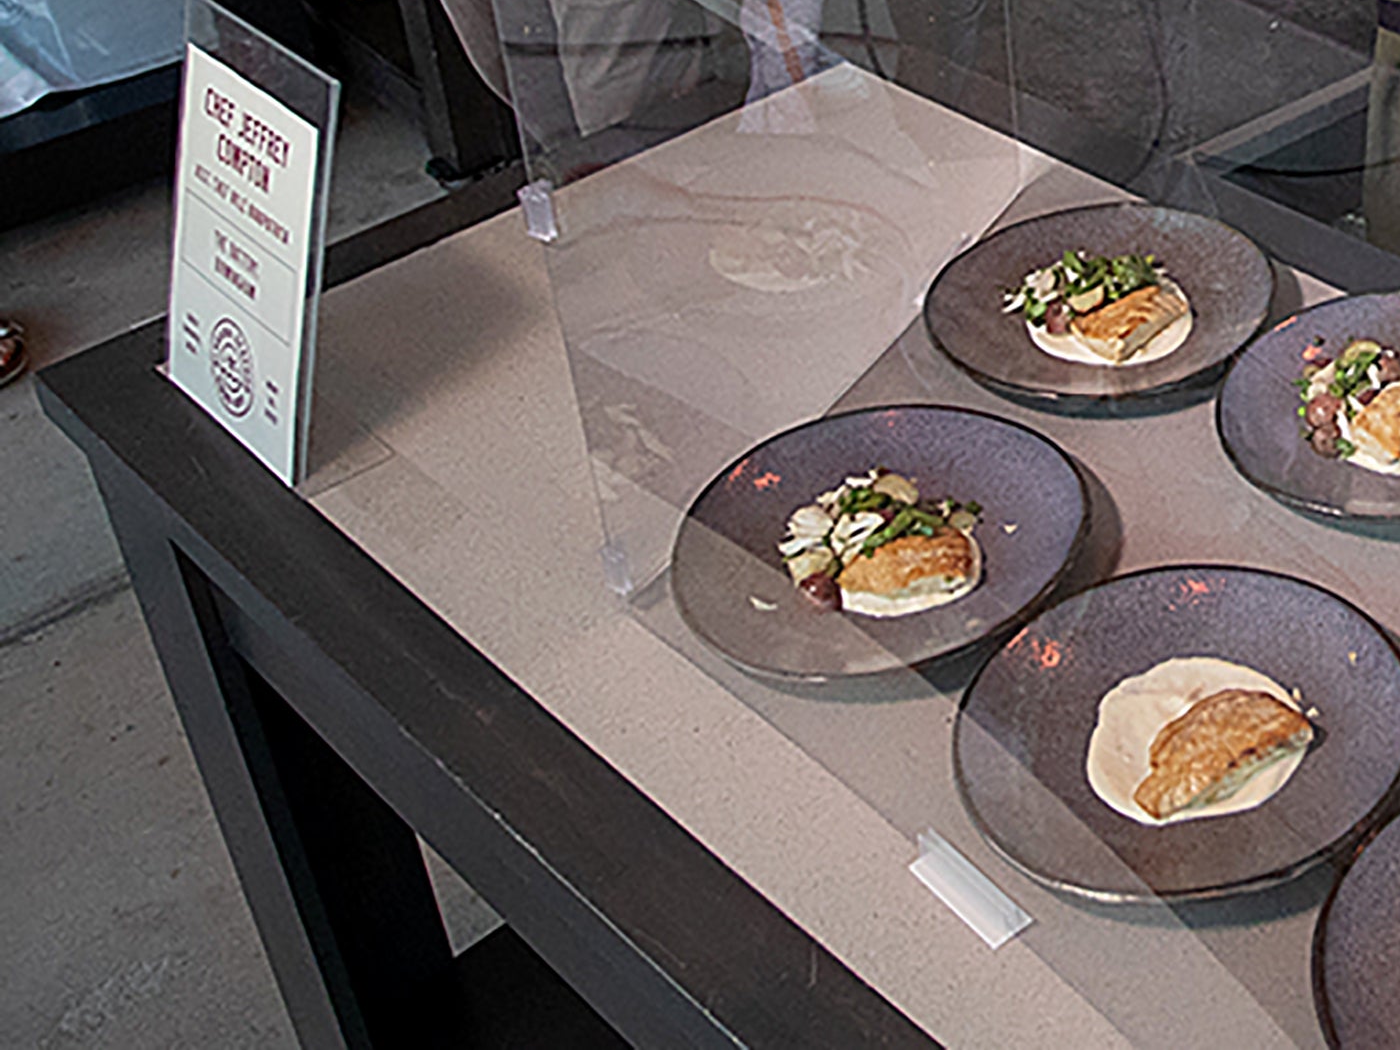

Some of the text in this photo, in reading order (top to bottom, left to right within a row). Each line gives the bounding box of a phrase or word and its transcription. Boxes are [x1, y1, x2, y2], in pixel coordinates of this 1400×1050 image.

[206, 87, 291, 168] CHEF JEFFREY
[217, 133, 270, 193] COMPTON
